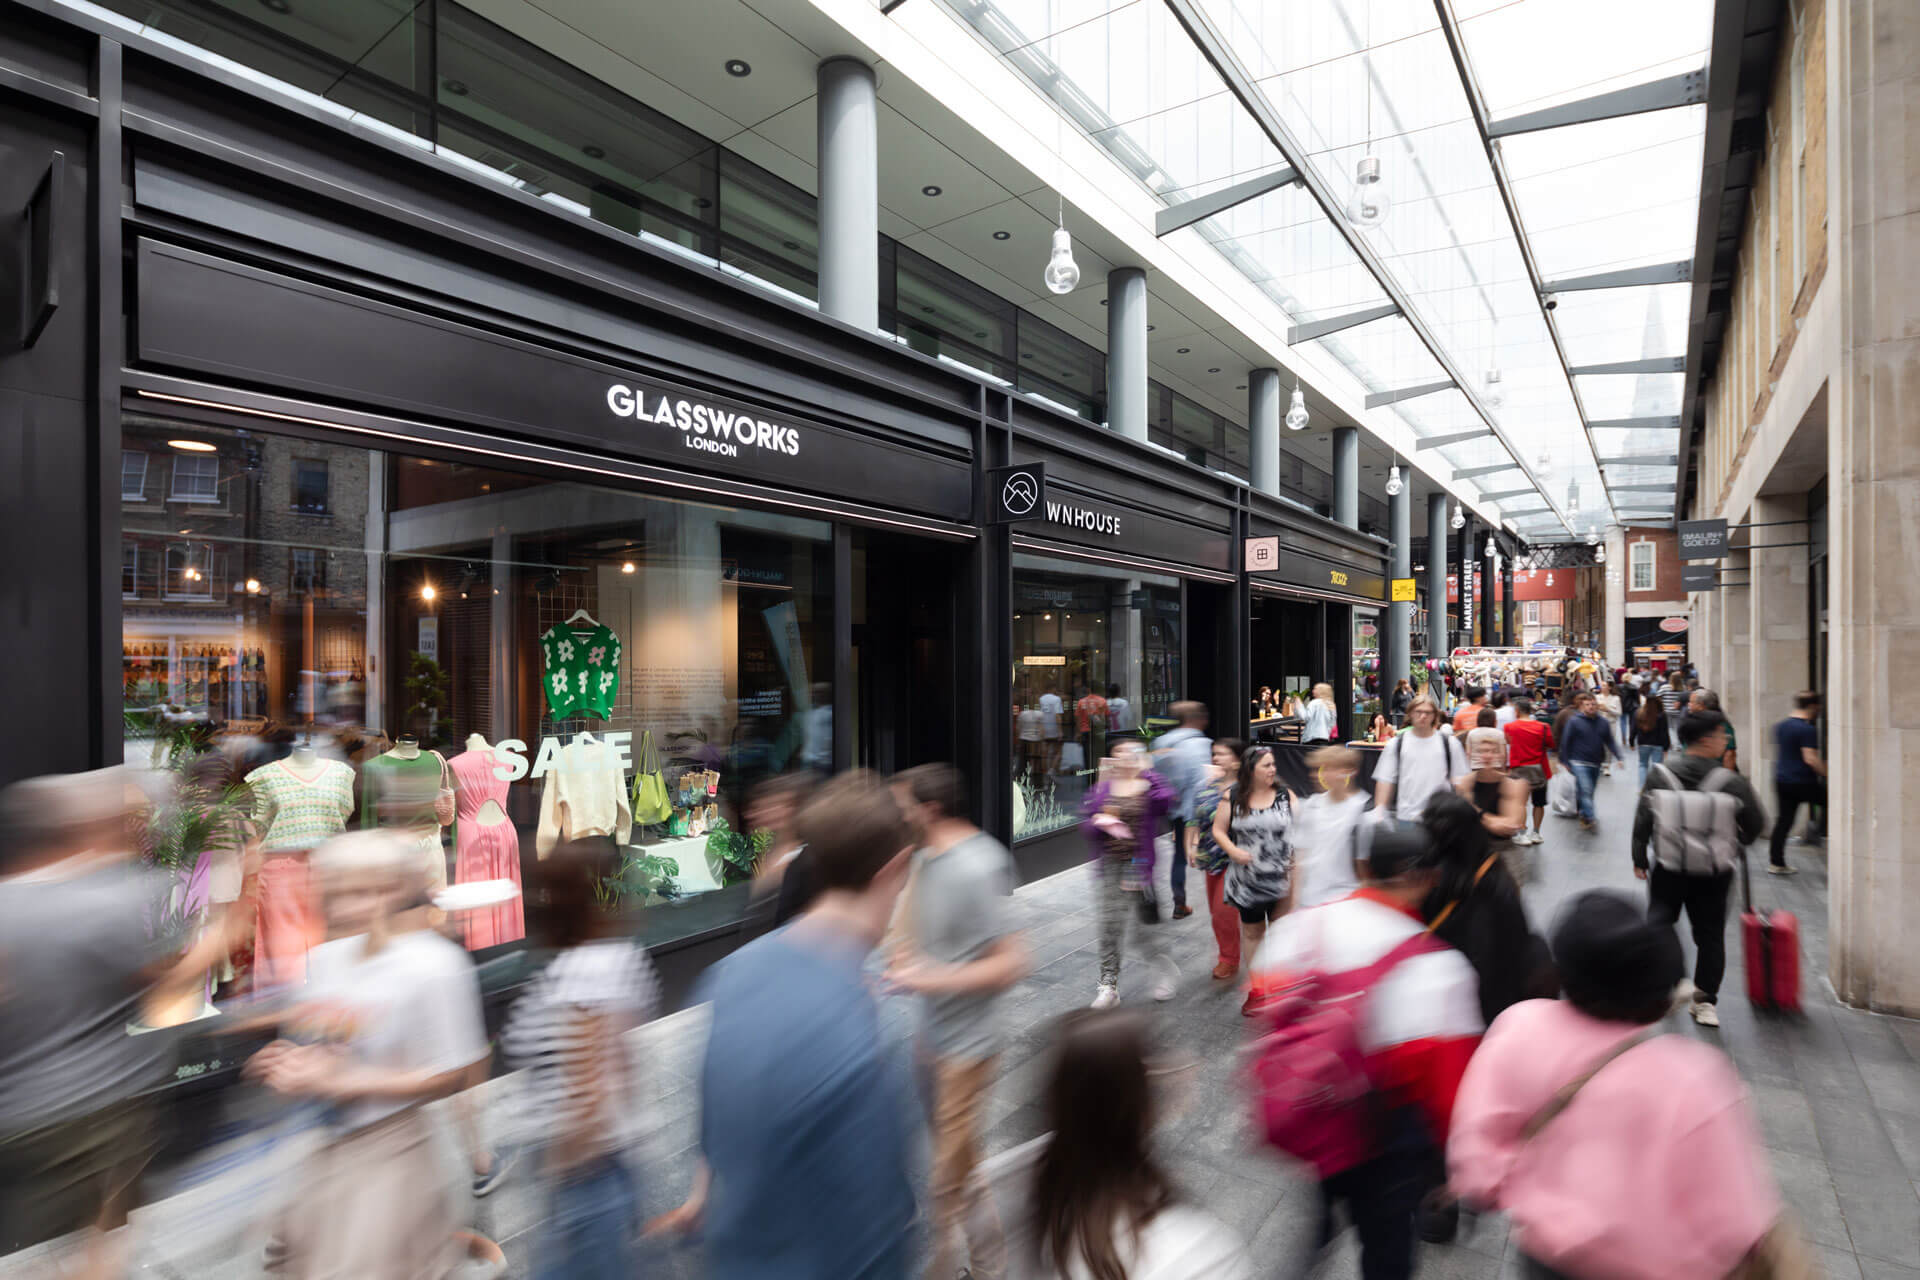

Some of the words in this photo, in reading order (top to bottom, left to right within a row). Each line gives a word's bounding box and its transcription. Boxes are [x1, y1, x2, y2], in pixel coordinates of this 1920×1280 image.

[607, 384, 800, 456] GLASSWORKS
[686, 435, 738, 457] LONDON
[1464, 559, 1472, 590] STREET
[1464, 593, 1472, 629] MARKET
[493, 731, 632, 781] SALE
